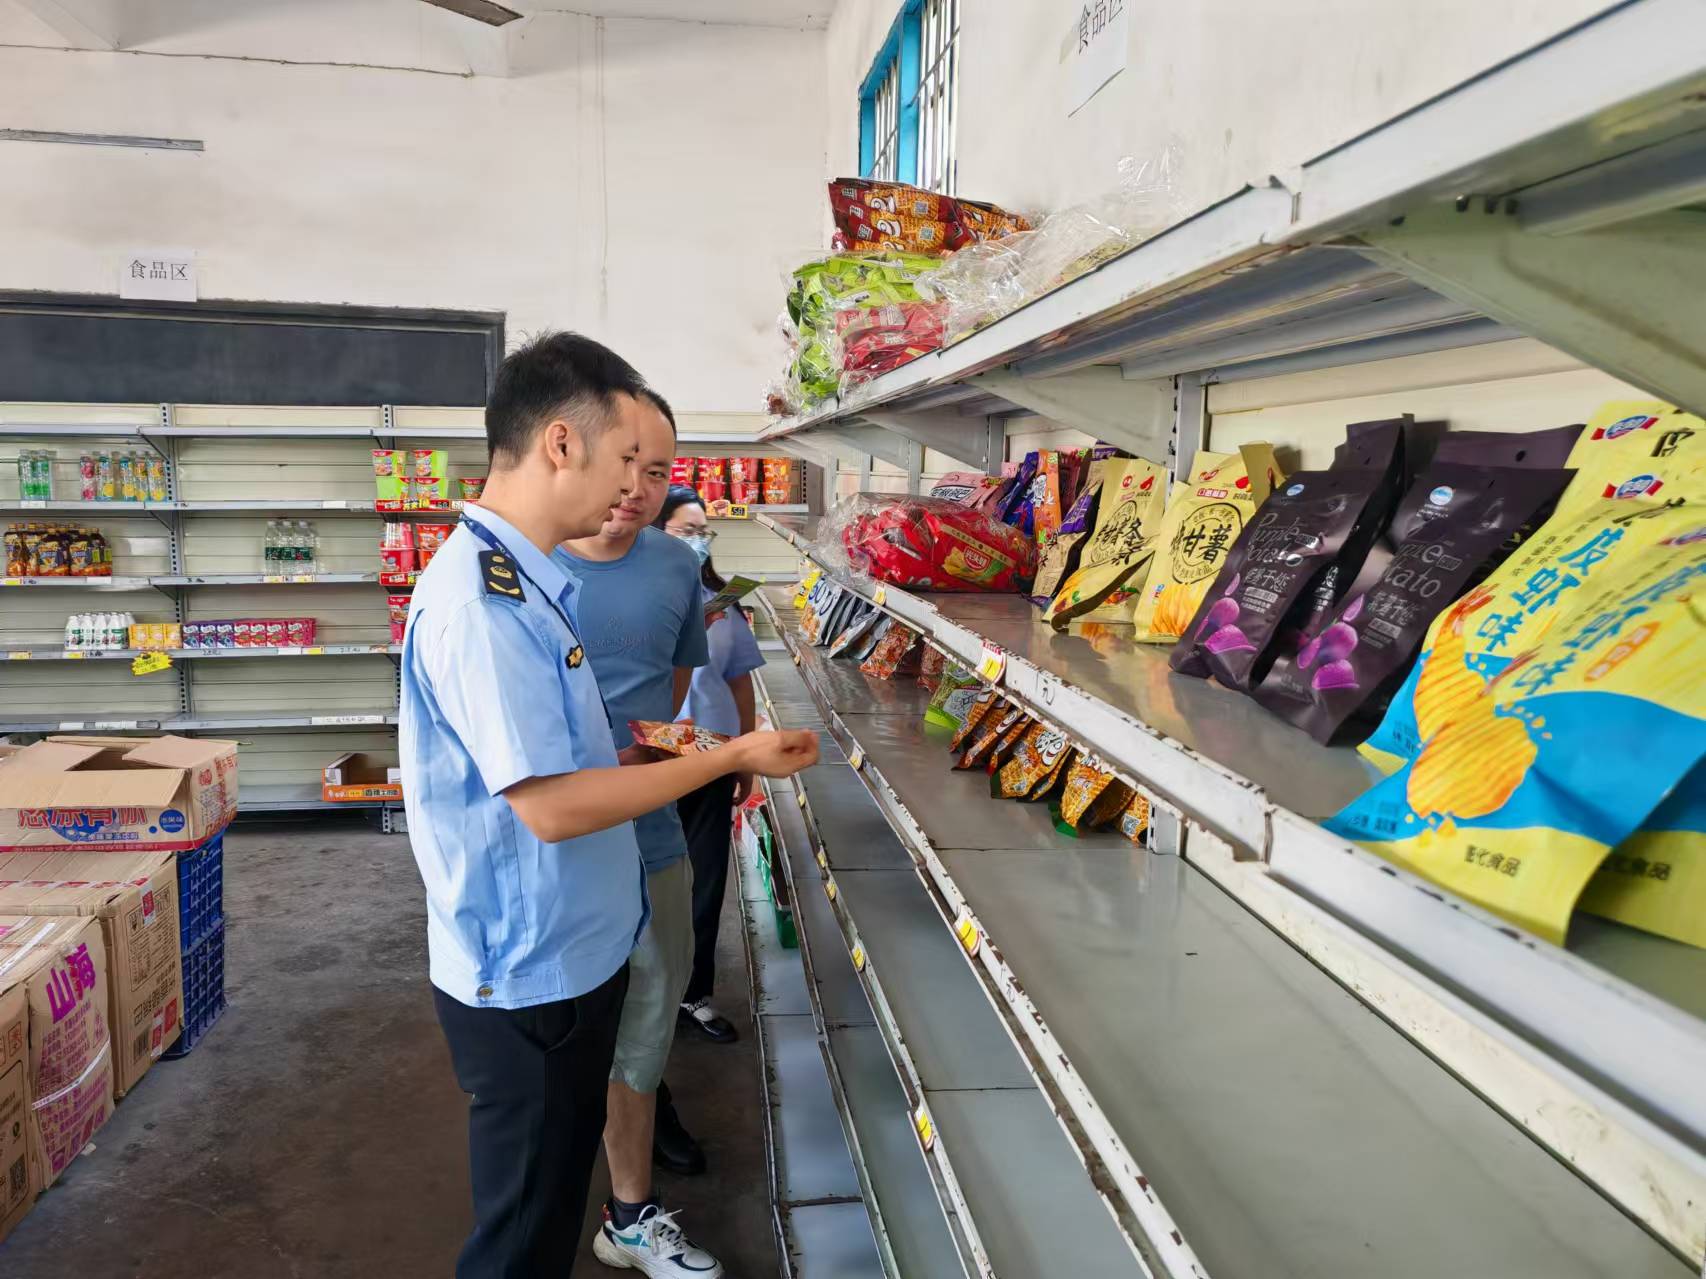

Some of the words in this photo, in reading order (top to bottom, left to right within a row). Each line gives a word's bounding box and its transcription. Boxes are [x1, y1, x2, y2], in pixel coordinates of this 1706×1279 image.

[129, 259, 189, 281] 食品区
[1181, 523, 1233, 564] 甘薯
